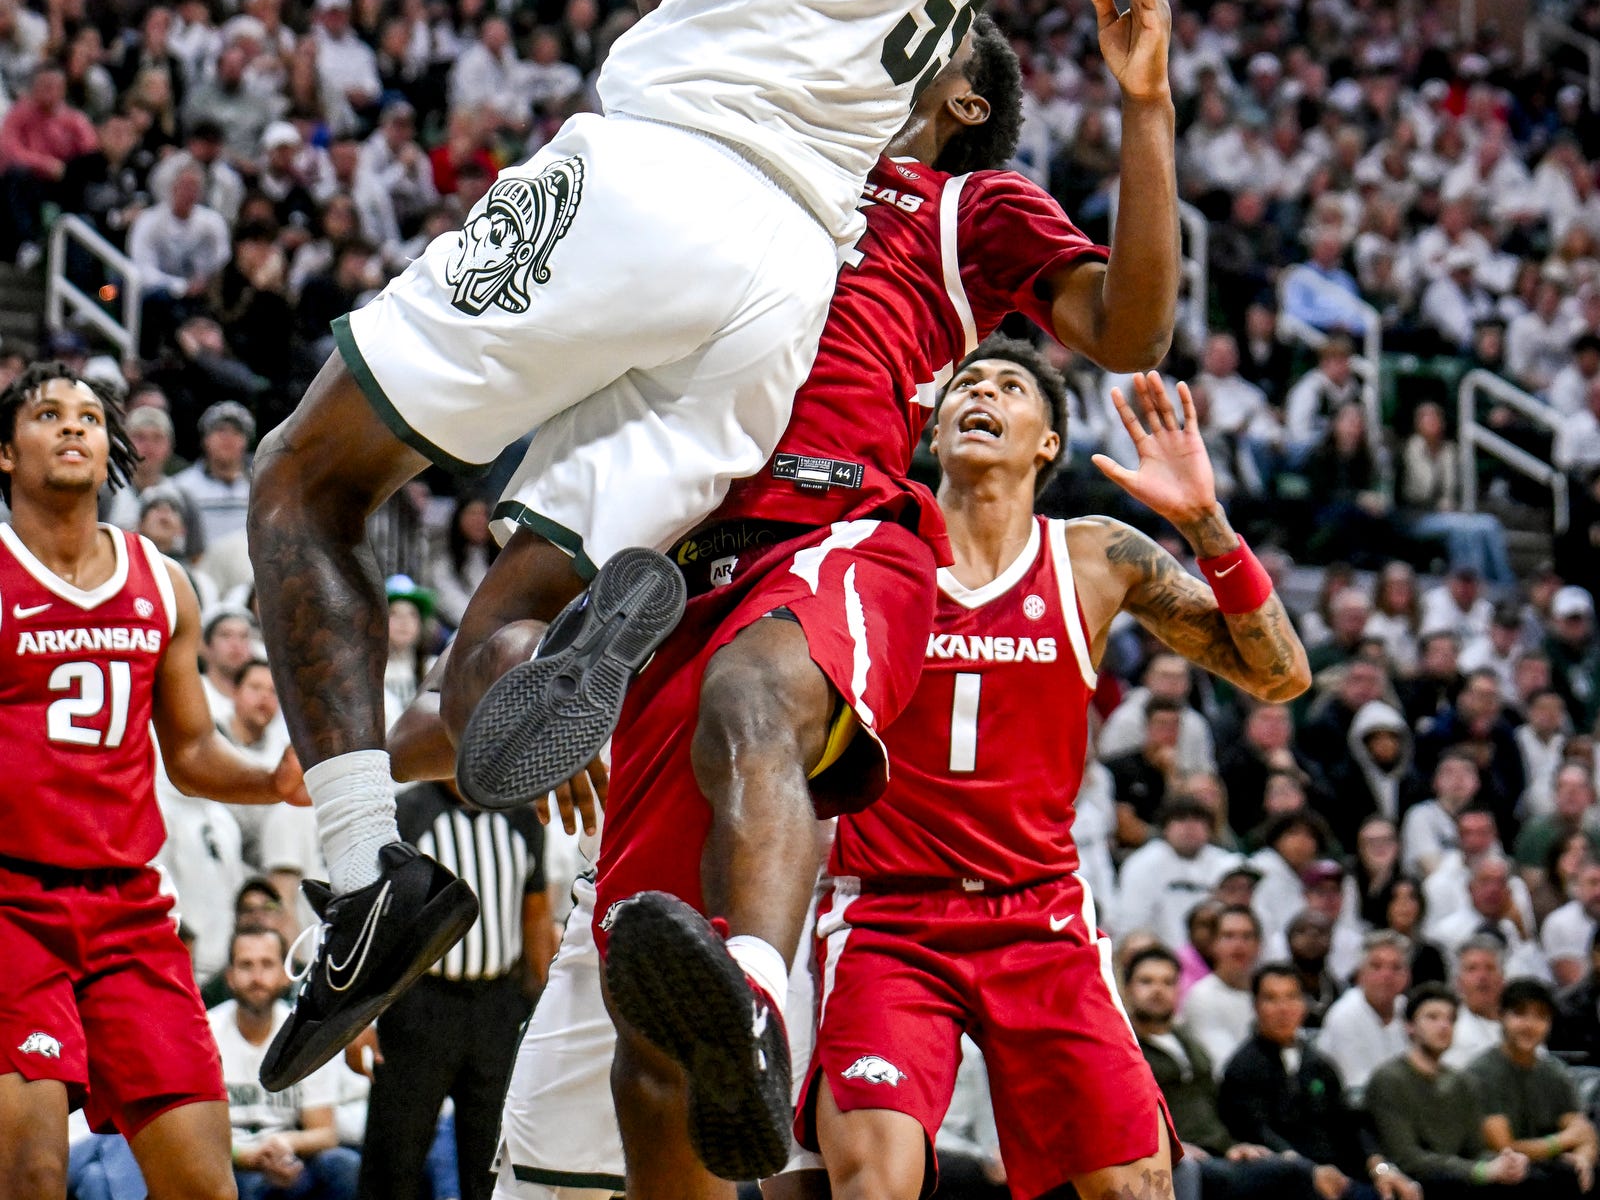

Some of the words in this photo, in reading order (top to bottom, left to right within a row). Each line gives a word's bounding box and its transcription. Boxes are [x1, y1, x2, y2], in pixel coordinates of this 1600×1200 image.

[835, 467, 851, 480] 44
[16, 627, 162, 656] ARKANSAS
[925, 632, 1058, 663] KANSAS
[46, 661, 132, 748] 21
[949, 672, 982, 772] 1
